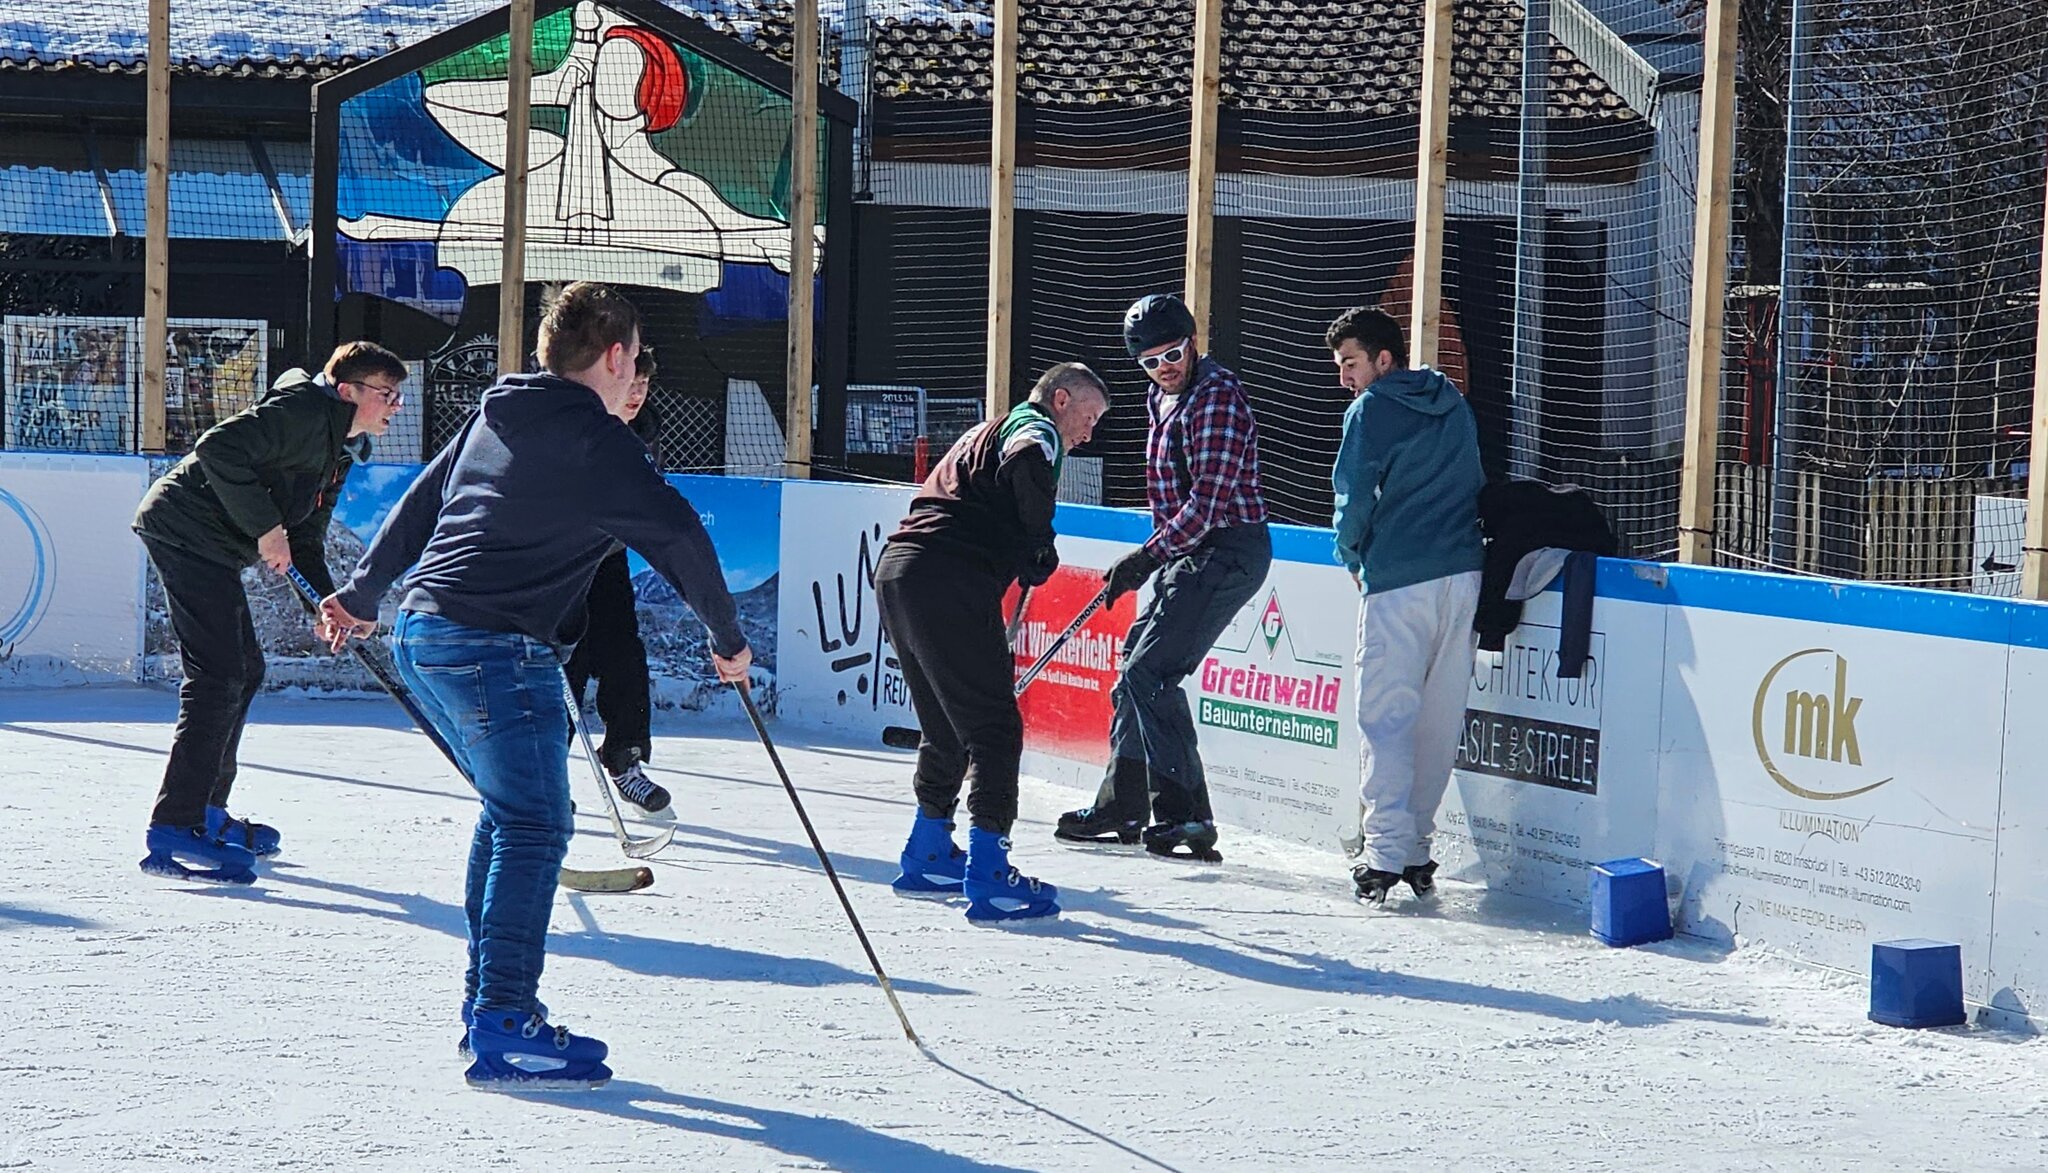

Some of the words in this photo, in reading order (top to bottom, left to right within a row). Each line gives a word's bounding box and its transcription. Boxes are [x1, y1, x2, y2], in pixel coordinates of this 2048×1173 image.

[1264, 612, 1280, 638] G
[1201, 657, 1342, 714] Greinwald
[1202, 699, 1333, 745] Bauunternehmen
[1784, 653, 1864, 767] mk
[1524, 728, 1595, 785] STRELE
[1780, 811, 1860, 842] ILLUMINATION
[1869, 868, 1884, 885] 512
